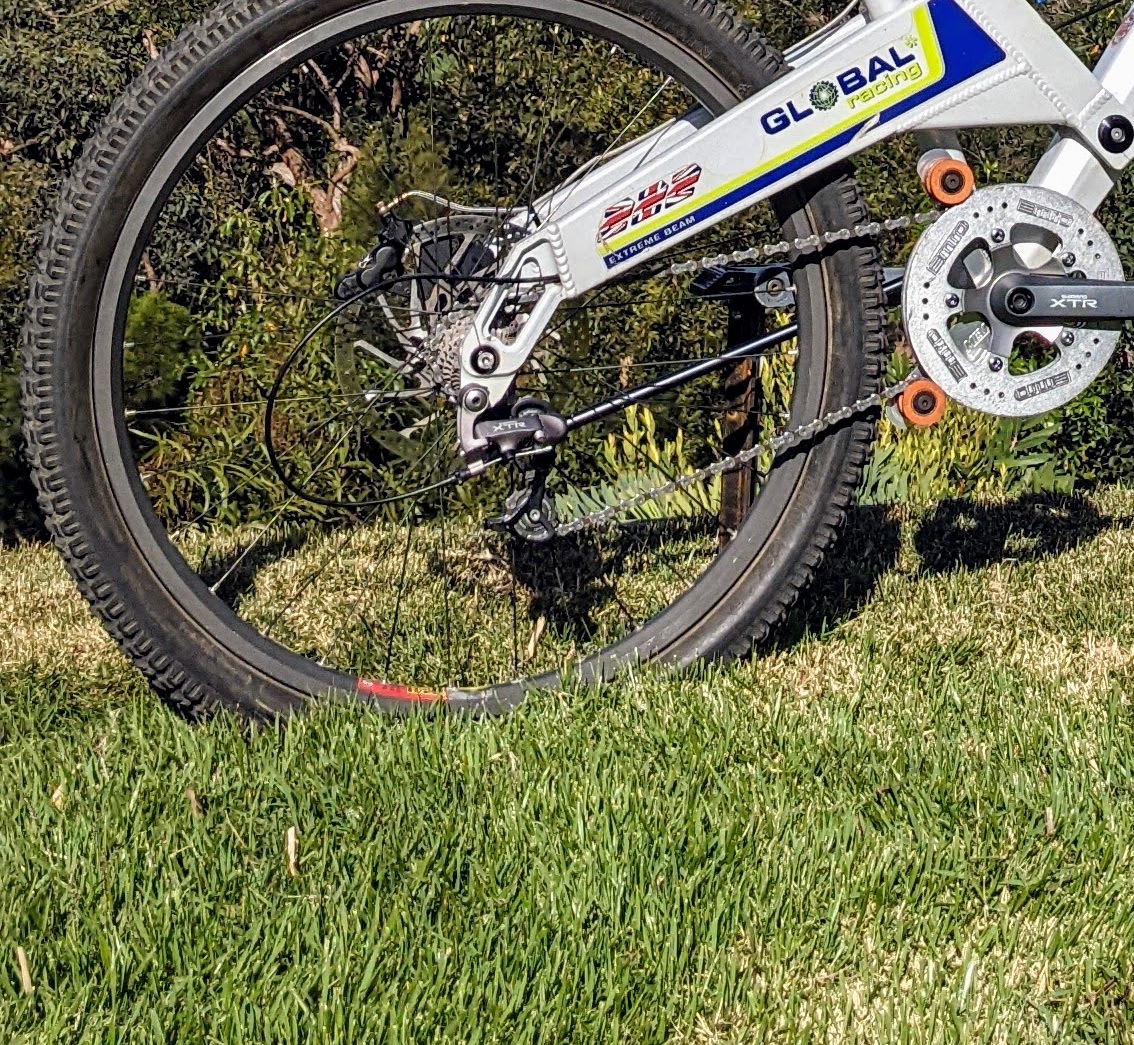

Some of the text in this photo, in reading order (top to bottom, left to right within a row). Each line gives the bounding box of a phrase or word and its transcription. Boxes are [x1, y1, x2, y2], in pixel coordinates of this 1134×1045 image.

[845, 61, 923, 110] racing
[608, 215, 696, 265] EXTREME BEAM
[1049, 298, 1098, 309] XTR
